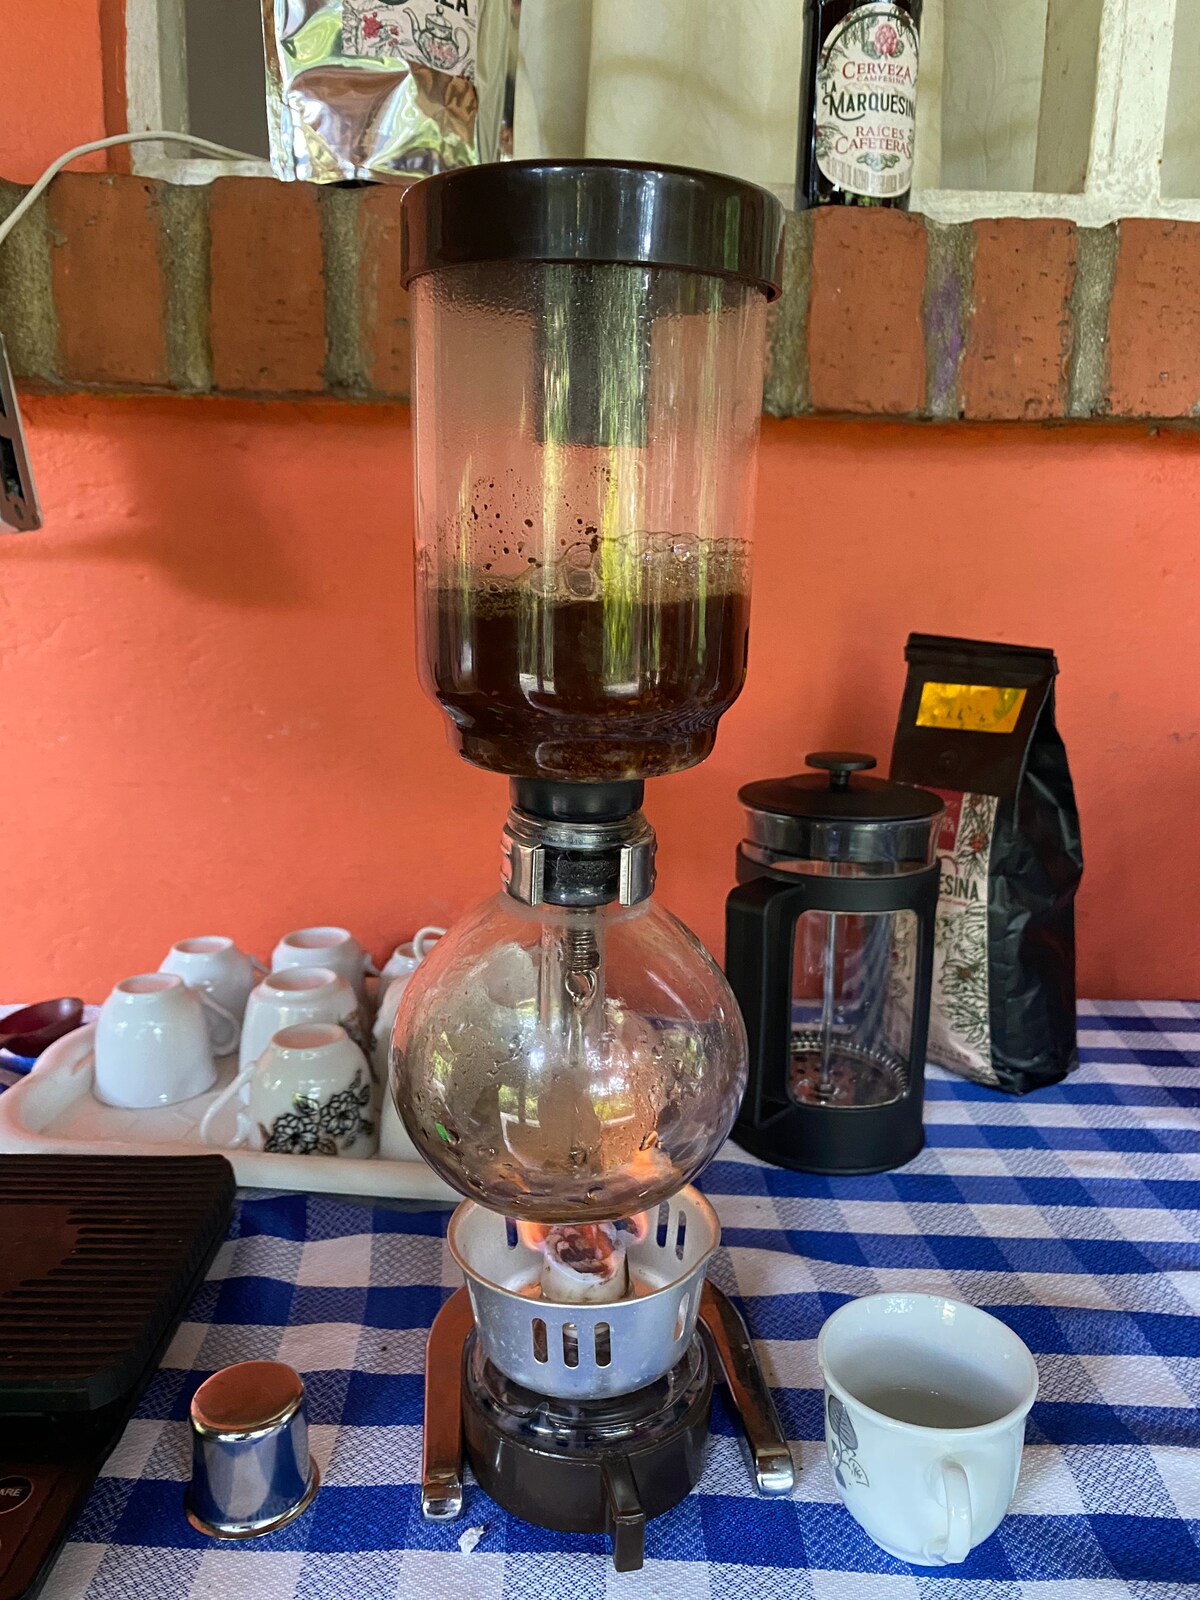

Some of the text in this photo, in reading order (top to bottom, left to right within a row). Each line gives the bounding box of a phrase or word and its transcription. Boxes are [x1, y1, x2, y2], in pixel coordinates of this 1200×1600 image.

[842, 61, 913, 85] CERVEZA
[821, 81, 836, 94] LA
[822, 91, 915, 121] MARQUESIN
[835, 136, 912, 159] CAFETERAS
[939, 874, 978, 900] ESINA
[0, 1488, 22, 1496] ARE
